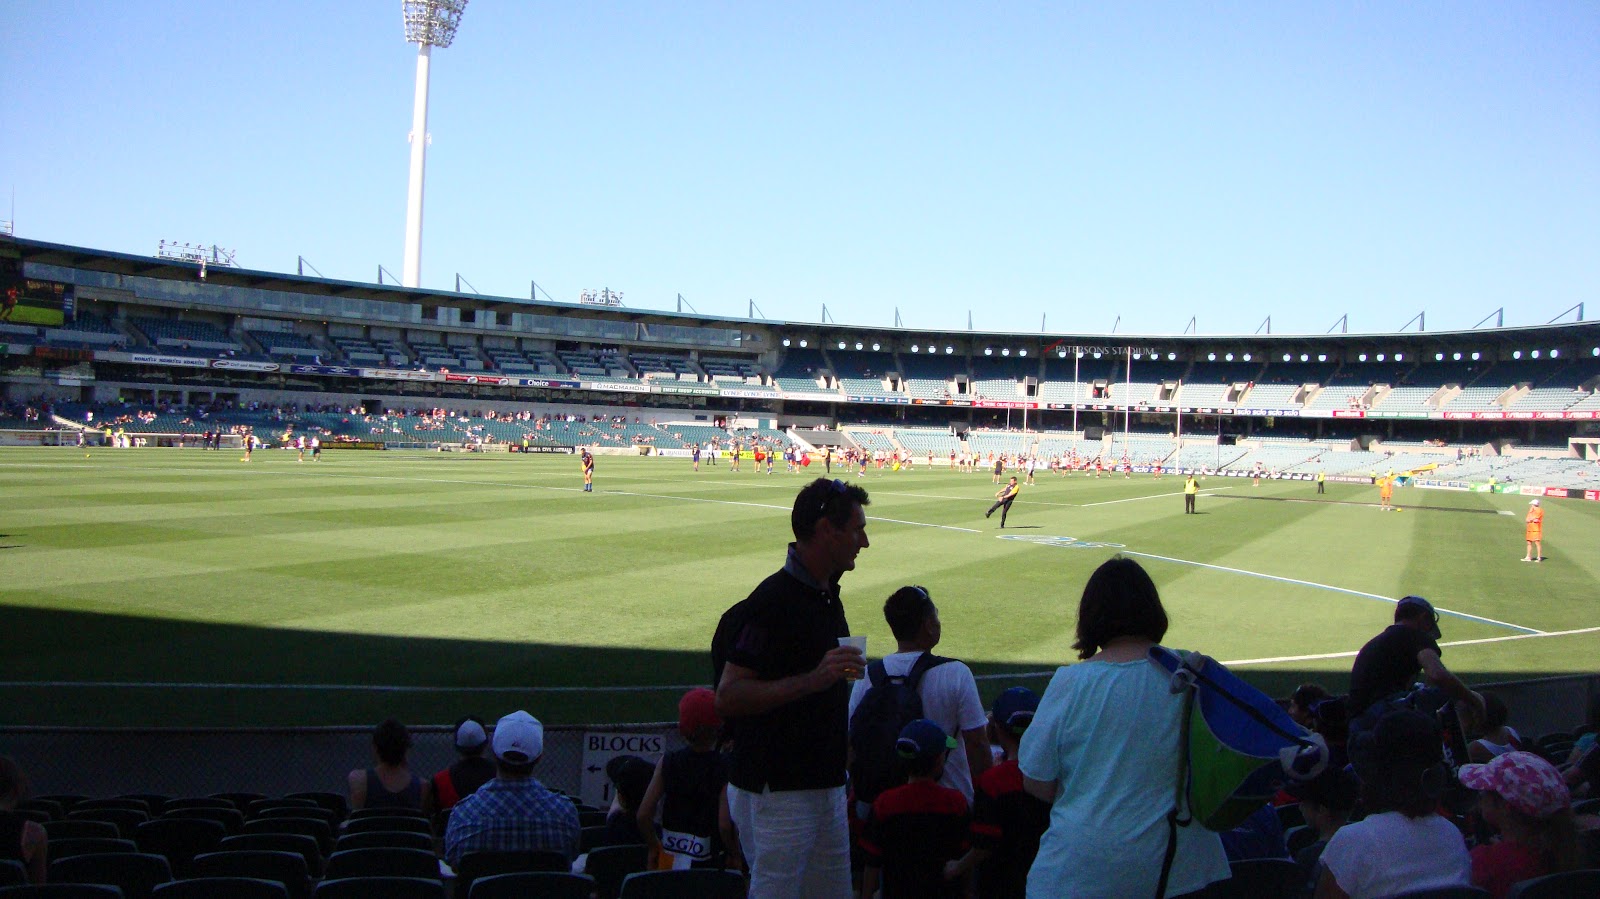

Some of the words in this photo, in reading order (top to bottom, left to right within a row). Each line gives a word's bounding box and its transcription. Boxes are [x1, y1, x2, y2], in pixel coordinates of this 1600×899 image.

[1055, 345, 1110, 355] PATERSONS
[1112, 346, 1155, 355] STADIUM
[589, 736, 661, 752] BLOCKS
